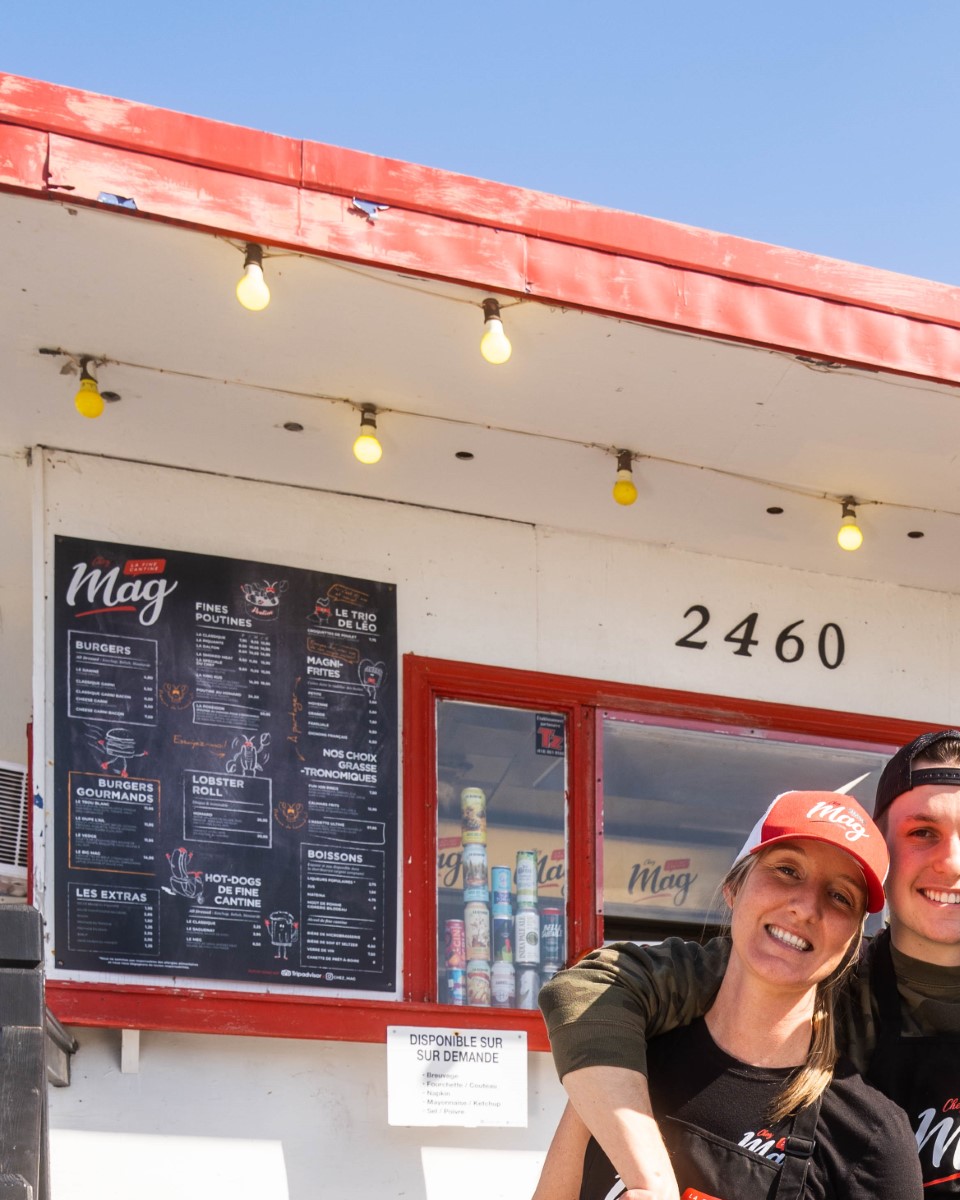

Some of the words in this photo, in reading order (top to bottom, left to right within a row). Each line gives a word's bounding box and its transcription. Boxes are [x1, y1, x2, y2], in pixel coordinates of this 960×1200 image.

[66, 562, 178, 626] Mag
[195, 602, 228, 614] FINES
[335, 608, 348, 617] LE
[351, 610, 377, 622] TRIO
[195, 612, 252, 628] POUTINES
[338, 619, 352, 628] DE
[356, 620, 377, 632] LÉO
[675, 604, 845, 670] 2460
[76, 640, 132, 656] BURGERS
[307, 656, 343, 668] MAGNI-
[307, 666, 340, 678] FRITES
[323, 748, 344, 758] NOS
[346, 751, 377, 762] CHOIX
[338, 761, 377, 773] GRASSE
[192, 775, 244, 788] LOBSTER
[300, 767, 377, 783] -TRONOMIQUES
[98, 778, 154, 792] BURGERS
[192, 785, 222, 797] ROLL
[76, 787, 154, 803] GOURMANDS
[806, 801, 870, 842] Mag
[307, 850, 363, 863] BOISSONS
[205, 873, 262, 886] HOT-DOGS
[628, 864, 698, 906] Mag
[76, 888, 98, 898] LES
[101, 890, 148, 903] EXTRAS
[218, 884, 232, 895] DE
[235, 886, 259, 897] FINE
[214, 896, 262, 908] CANTINE
[410, 1034, 477, 1048] DISPONIBLE
[480, 1037, 503, 1048] SUR
[417, 1049, 440, 1061] SUR
[444, 1051, 499, 1063] DEMANDE
[738, 1131, 786, 1165] Ma
